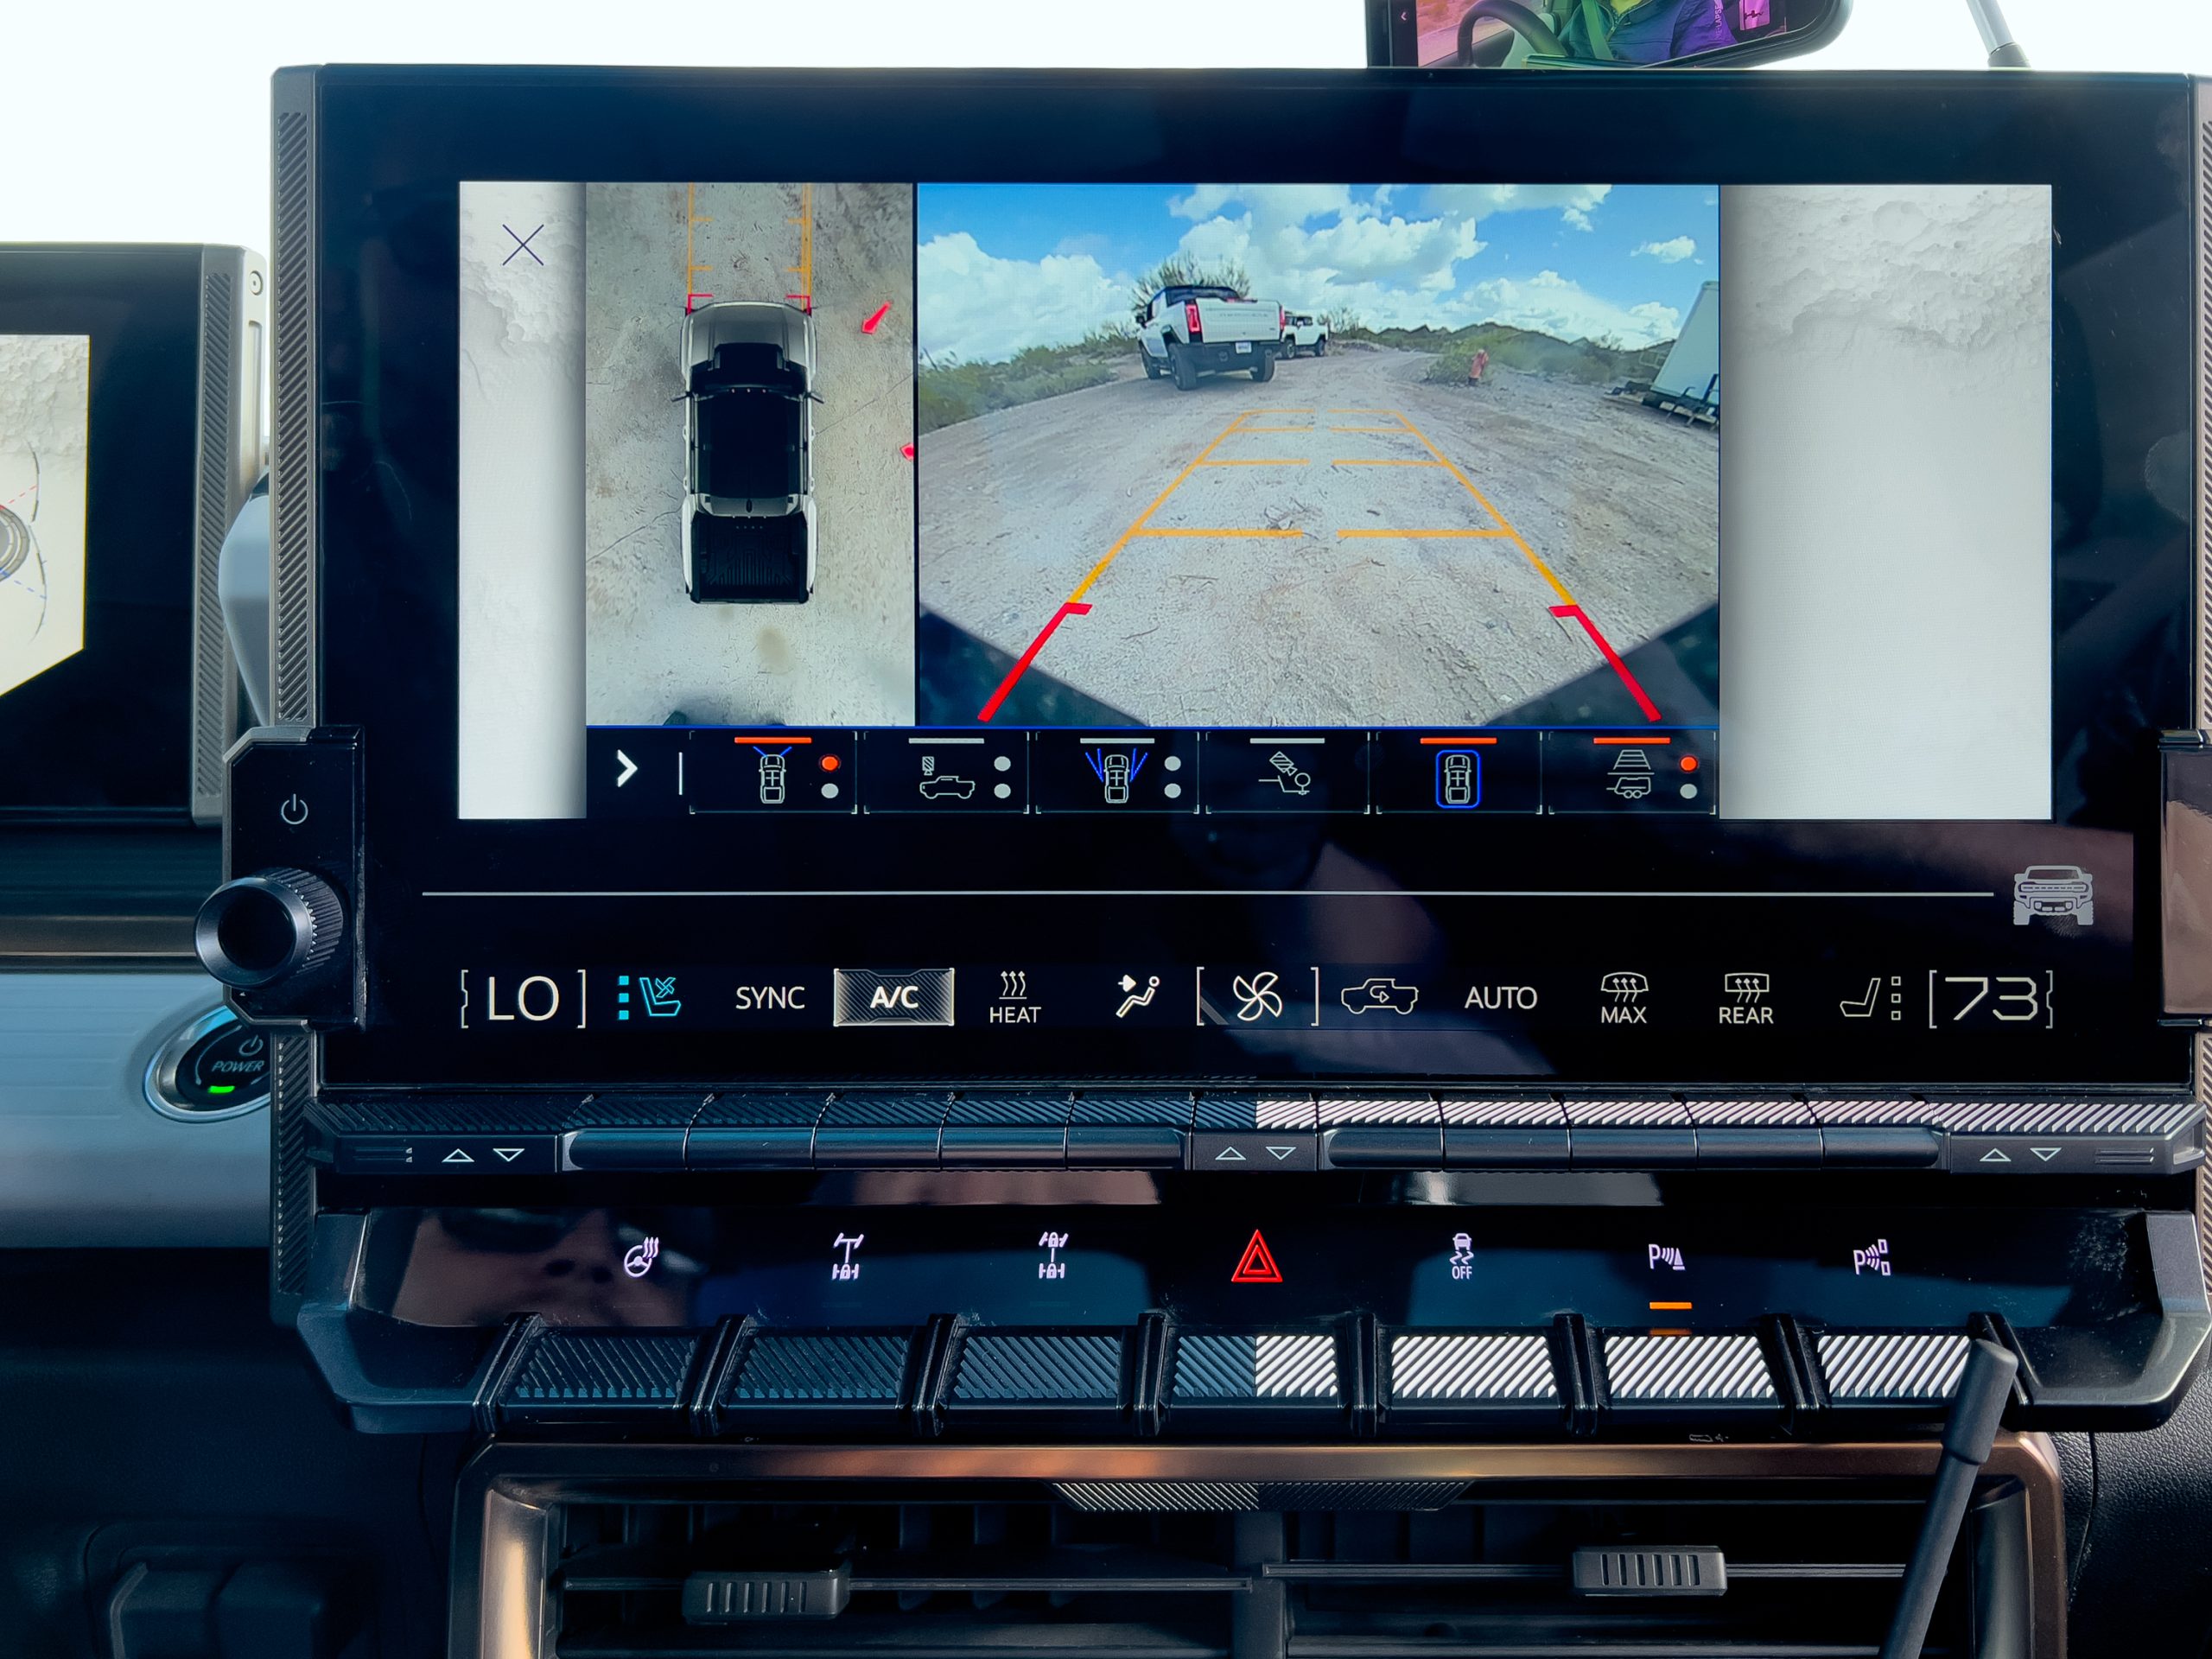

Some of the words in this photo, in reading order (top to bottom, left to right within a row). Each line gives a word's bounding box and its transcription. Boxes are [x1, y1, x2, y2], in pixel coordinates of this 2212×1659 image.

[488, 976, 560, 1021] LO
[735, 986, 805, 1010] SYNC
[869, 985, 918, 1008] A/C
[1464, 986, 1538, 1009] AUTO
[1944, 976, 2038, 1020] 73
[989, 1006, 1042, 1024] HEAT
[1601, 1006, 1647, 1024] MAX
[1719, 1007, 1774, 1024] REAR
[213, 1060, 265, 1072] POWER
[1451, 1265, 1473, 1281] OFF
